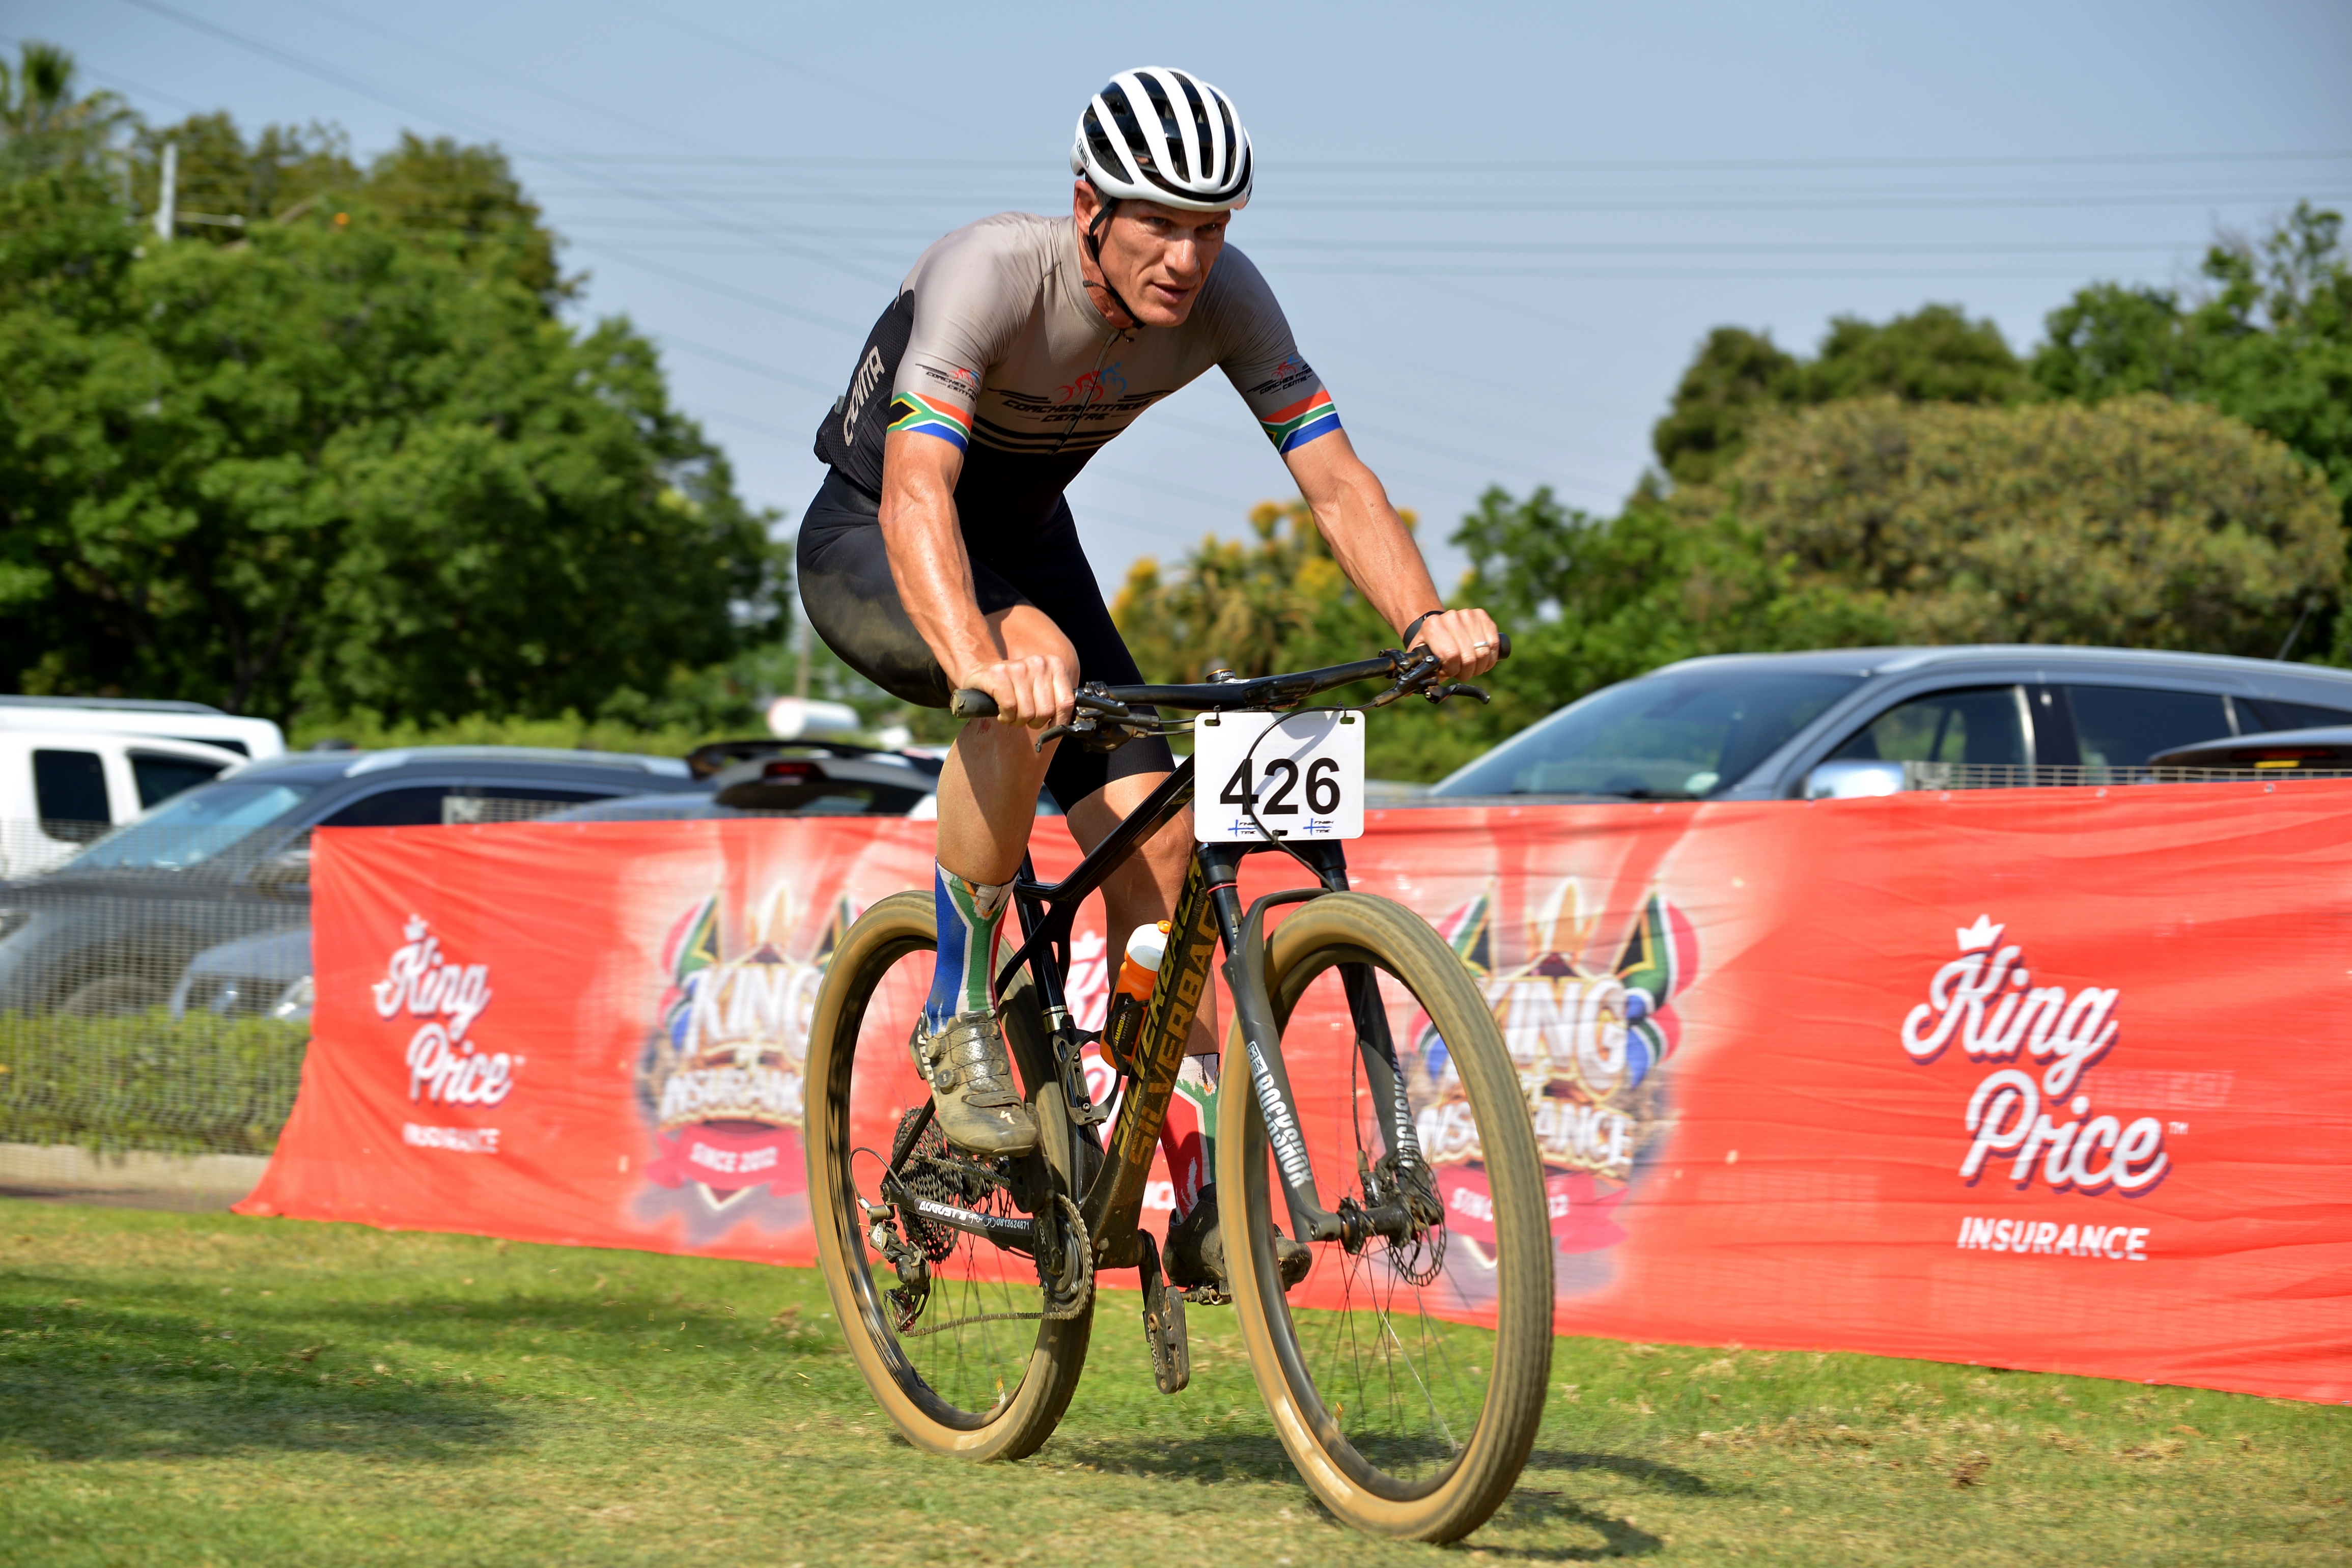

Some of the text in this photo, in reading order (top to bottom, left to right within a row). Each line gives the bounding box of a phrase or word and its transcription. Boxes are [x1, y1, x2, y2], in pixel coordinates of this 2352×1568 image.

[1001, 400, 1085, 413] COACHES
[1041, 413, 1110, 423] CENTRE
[1220, 757, 1340, 815] 426
[374, 937, 492, 1043] King
[1901, 945, 2120, 1096] King
[406, 1023, 514, 1105] Price
[1128, 900, 1218, 1170] SILVERBAC
[1254, 1073, 1313, 1189] ROCKSHOX
[1958, 1068, 2168, 1188] Price
[996, 1219, 1029, 1230] 0813624871
[1957, 1217, 2151, 1262] INSURANCE
